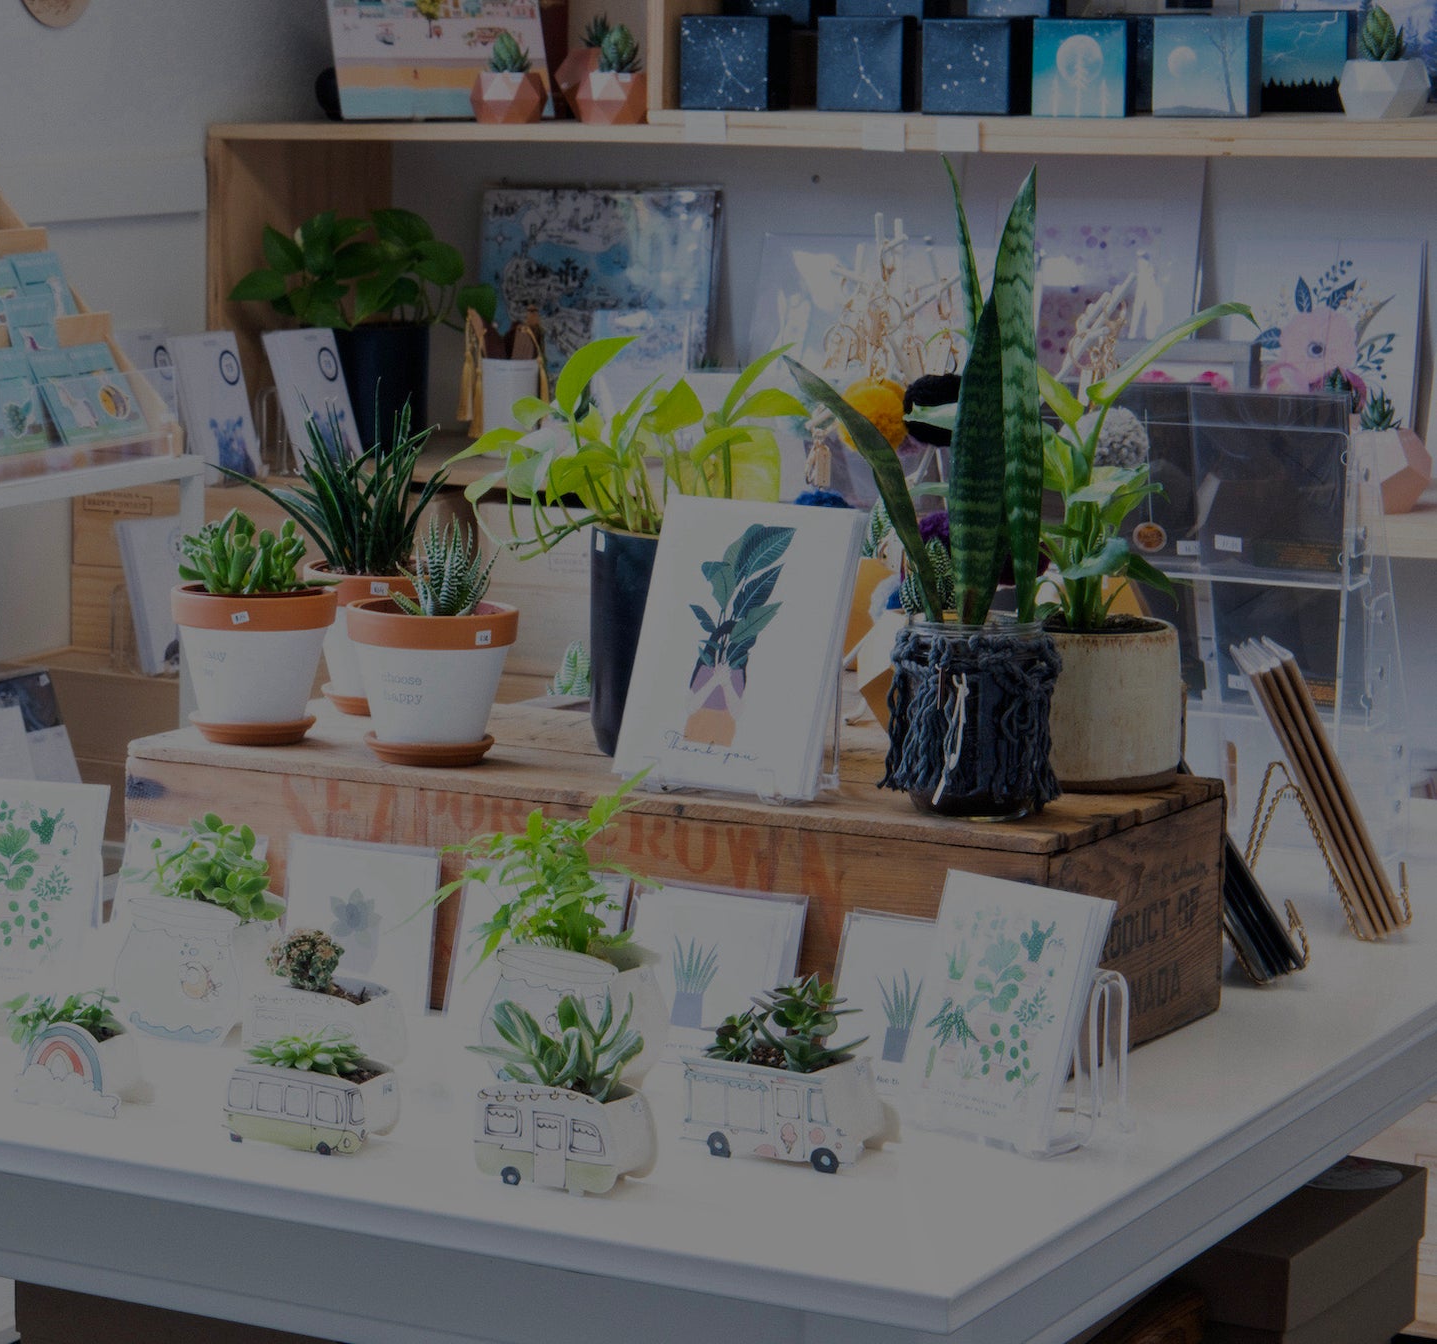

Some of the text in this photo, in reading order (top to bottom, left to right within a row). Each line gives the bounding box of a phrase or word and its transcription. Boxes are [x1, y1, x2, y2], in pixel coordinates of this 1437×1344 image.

[381, 671, 423, 686] choose
[383, 688, 423, 705] happy
[664, 729, 760, 764] Thank you
[1103, 885, 1201, 962] ODUCT OF
[1130, 960, 1182, 1016] NADA
